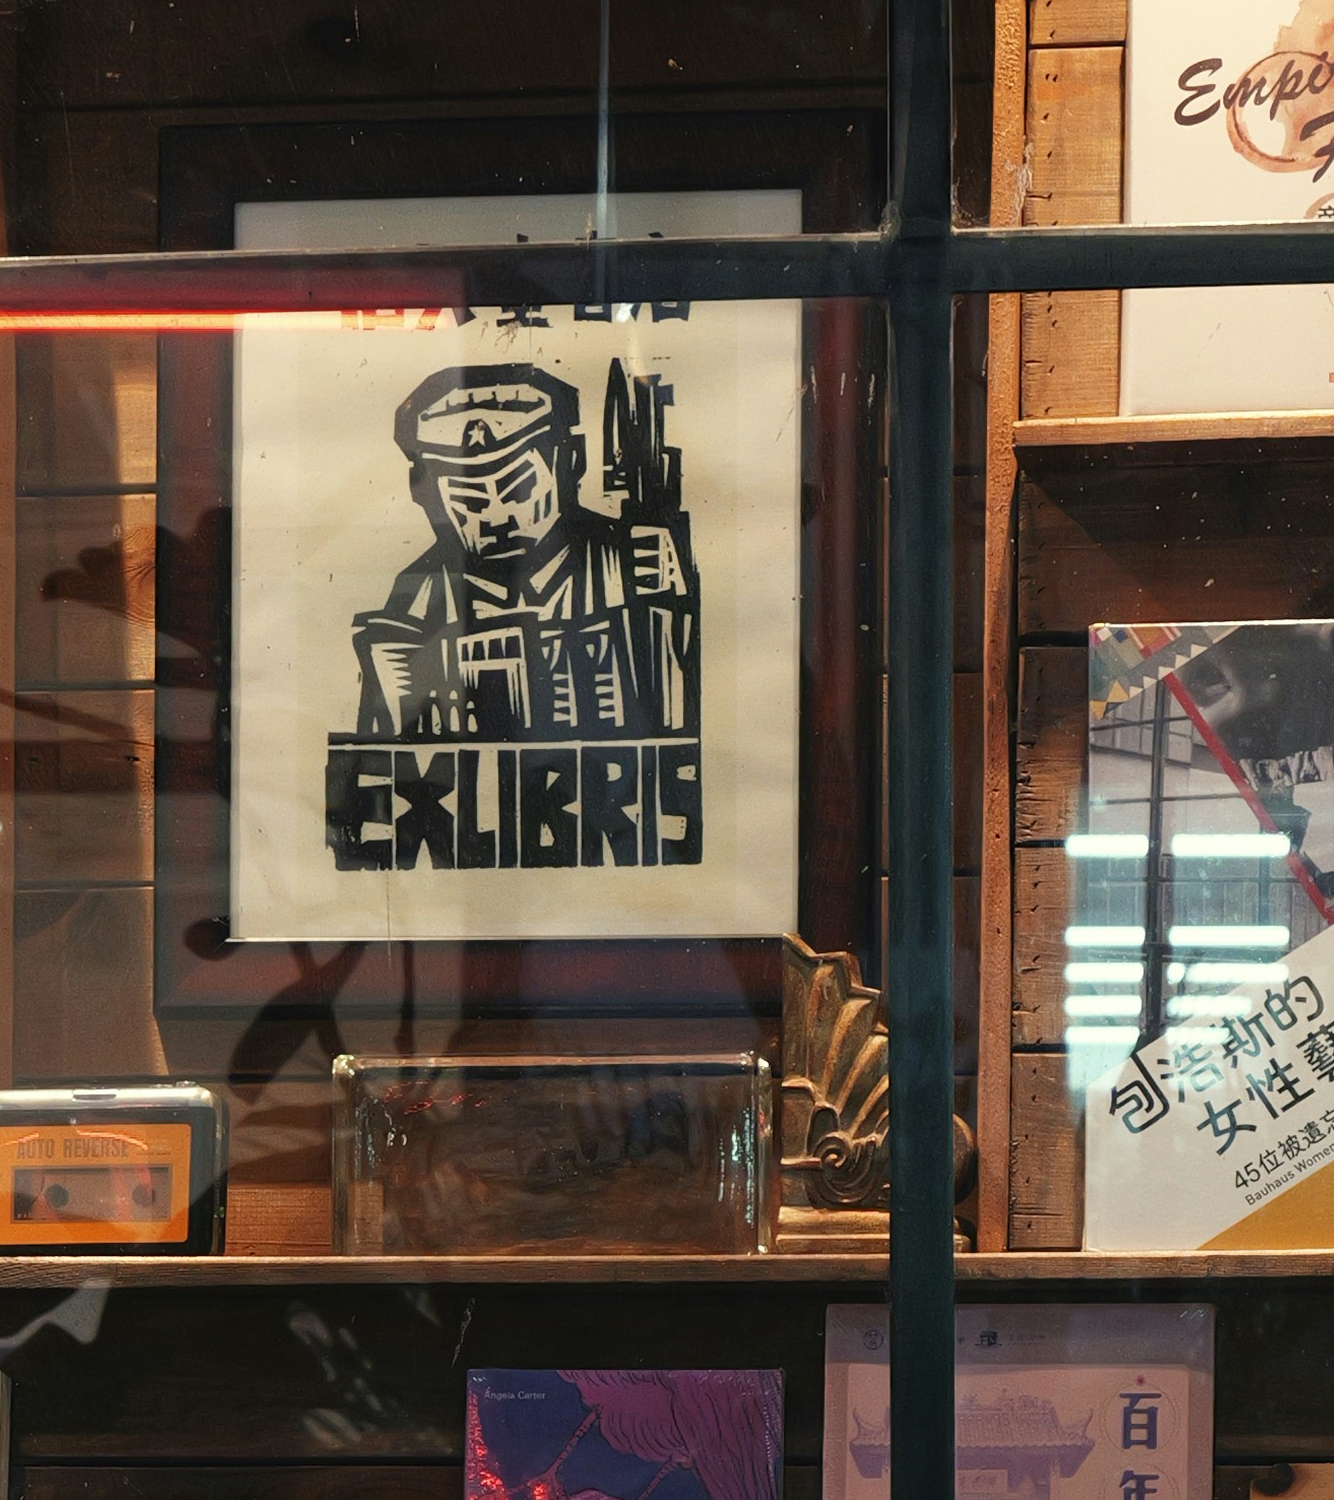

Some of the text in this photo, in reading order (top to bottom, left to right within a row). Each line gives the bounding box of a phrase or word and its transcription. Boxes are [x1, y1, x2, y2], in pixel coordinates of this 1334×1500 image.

[1108, 975, 1325, 1134] 包浩斯的
[1244, 1168, 1296, 1207] Bauhaus
[517, 1389, 547, 1400] Carter
